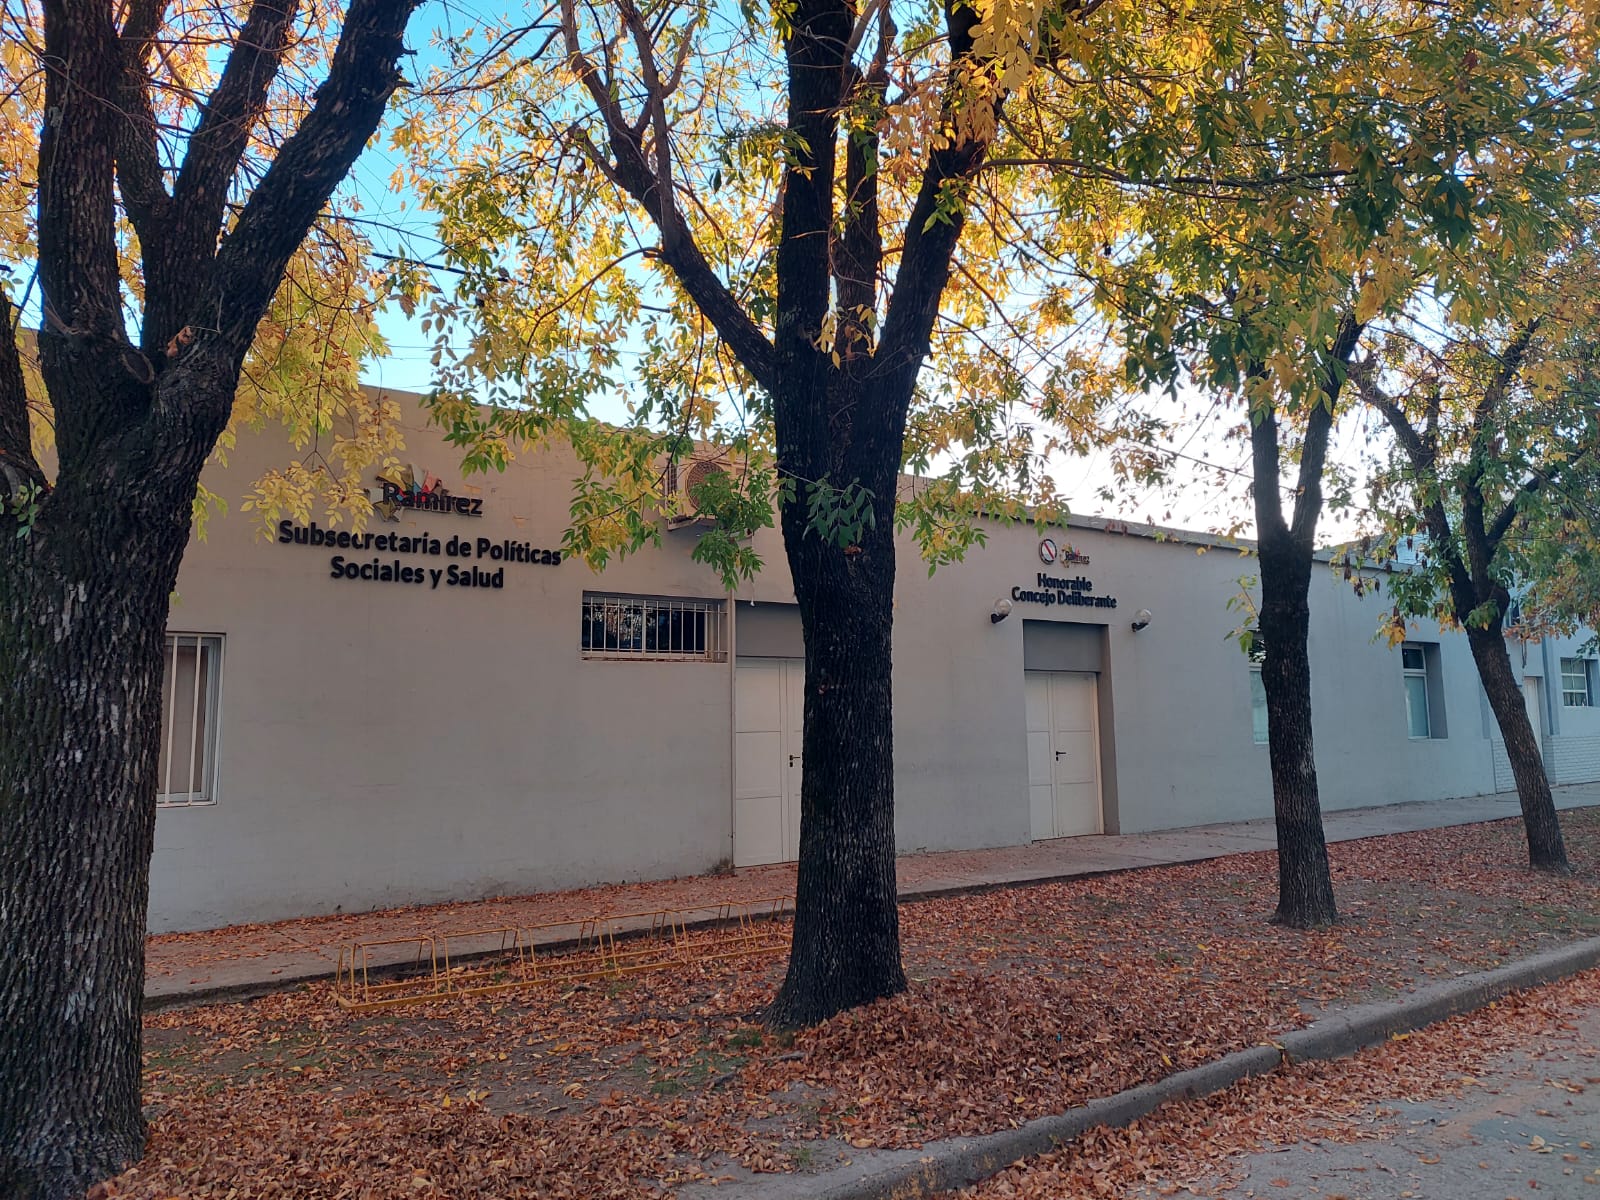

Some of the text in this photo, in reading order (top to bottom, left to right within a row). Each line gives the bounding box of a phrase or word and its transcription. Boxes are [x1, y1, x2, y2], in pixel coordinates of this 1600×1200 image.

[383, 479, 483, 516] Ramírez
[278, 519, 562, 566] Subsecretaría de Políticas
[330, 555, 504, 589] Sociales y Salud
[1037, 573, 1093, 591] Honorable
[1012, 586, 1117, 608] Concejo Deliberante
